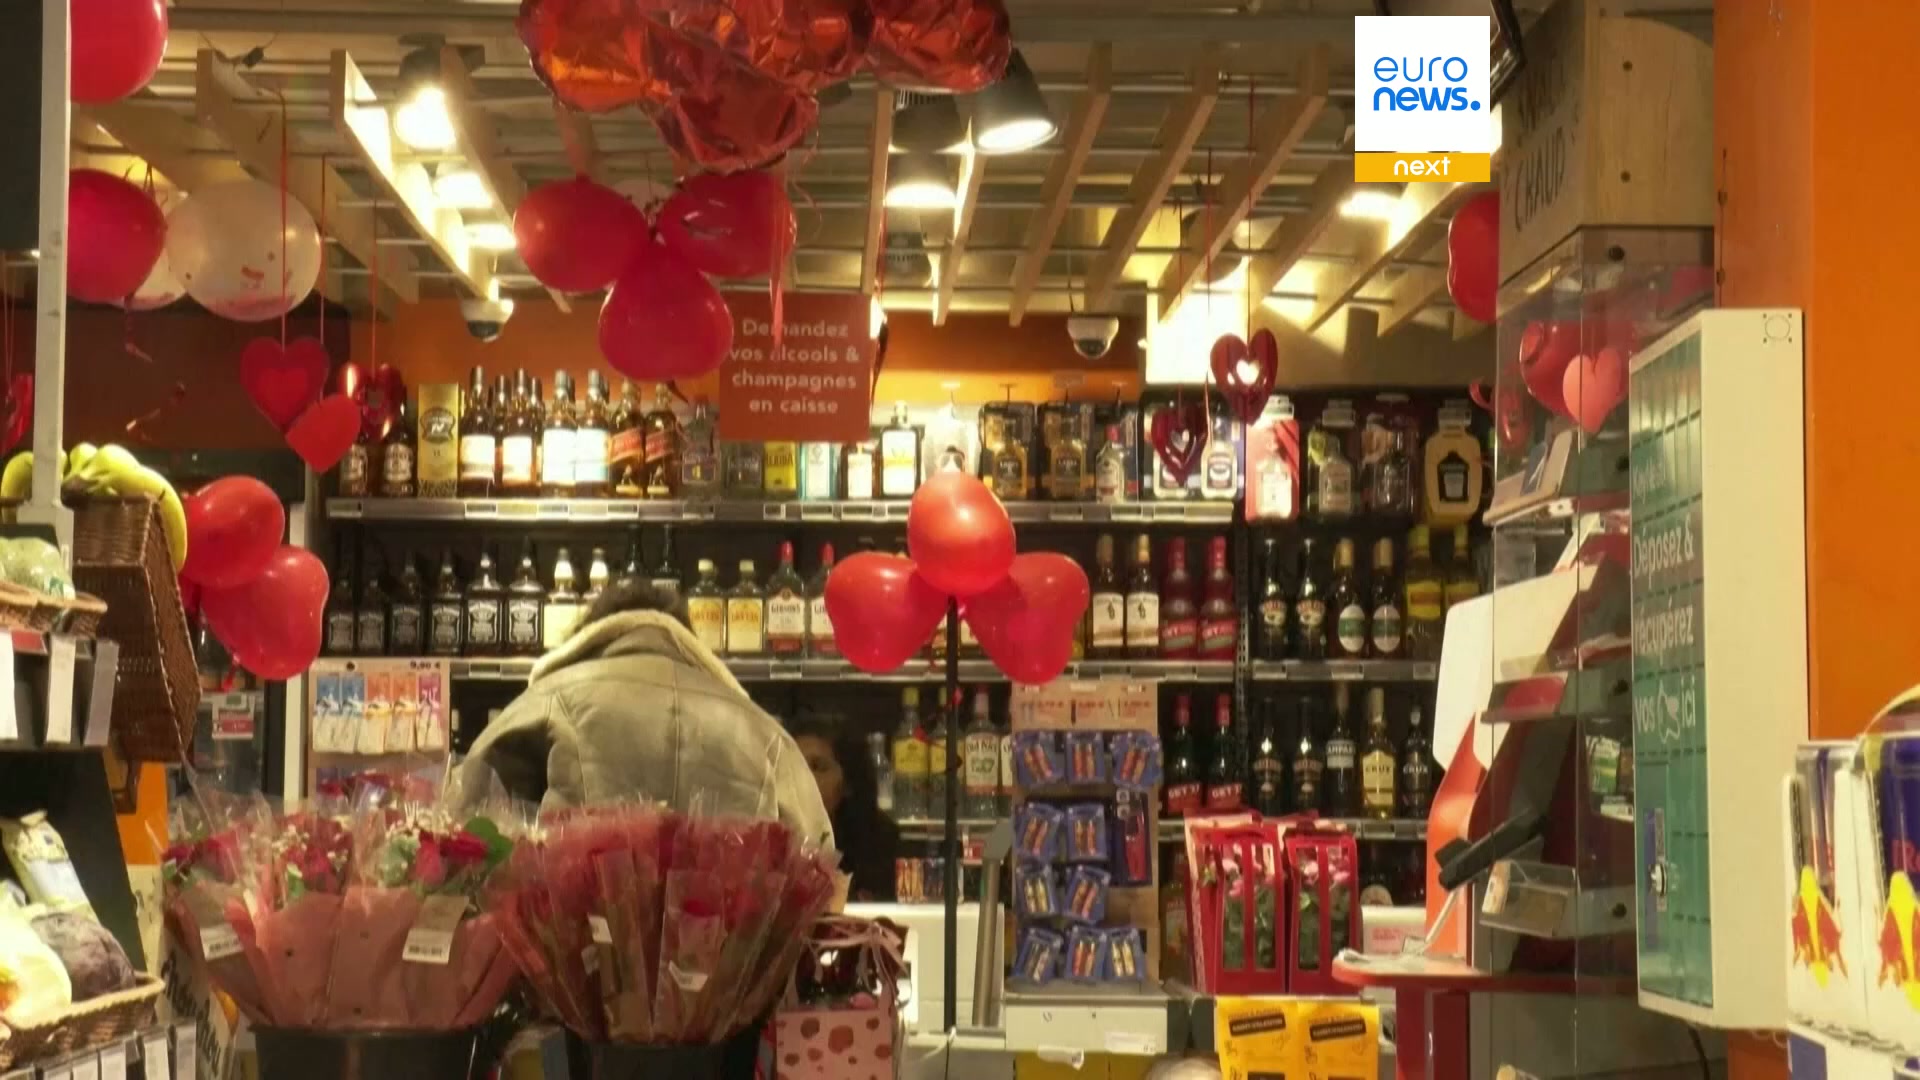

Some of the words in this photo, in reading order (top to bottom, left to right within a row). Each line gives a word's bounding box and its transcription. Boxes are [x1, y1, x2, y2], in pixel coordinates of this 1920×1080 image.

[730, 347, 763, 361] vos
[846, 345, 860, 363] &
[732, 368, 857, 393] champagnes
[749, 399, 773, 413] en
[780, 397, 839, 414] caisse
[1633, 526, 1683, 587] Déposez
[1684, 511, 1694, 561] &
[1633, 598, 1694, 665] récupérez
[1634, 694, 1655, 734] vos
[1681, 677, 1696, 727] ici
